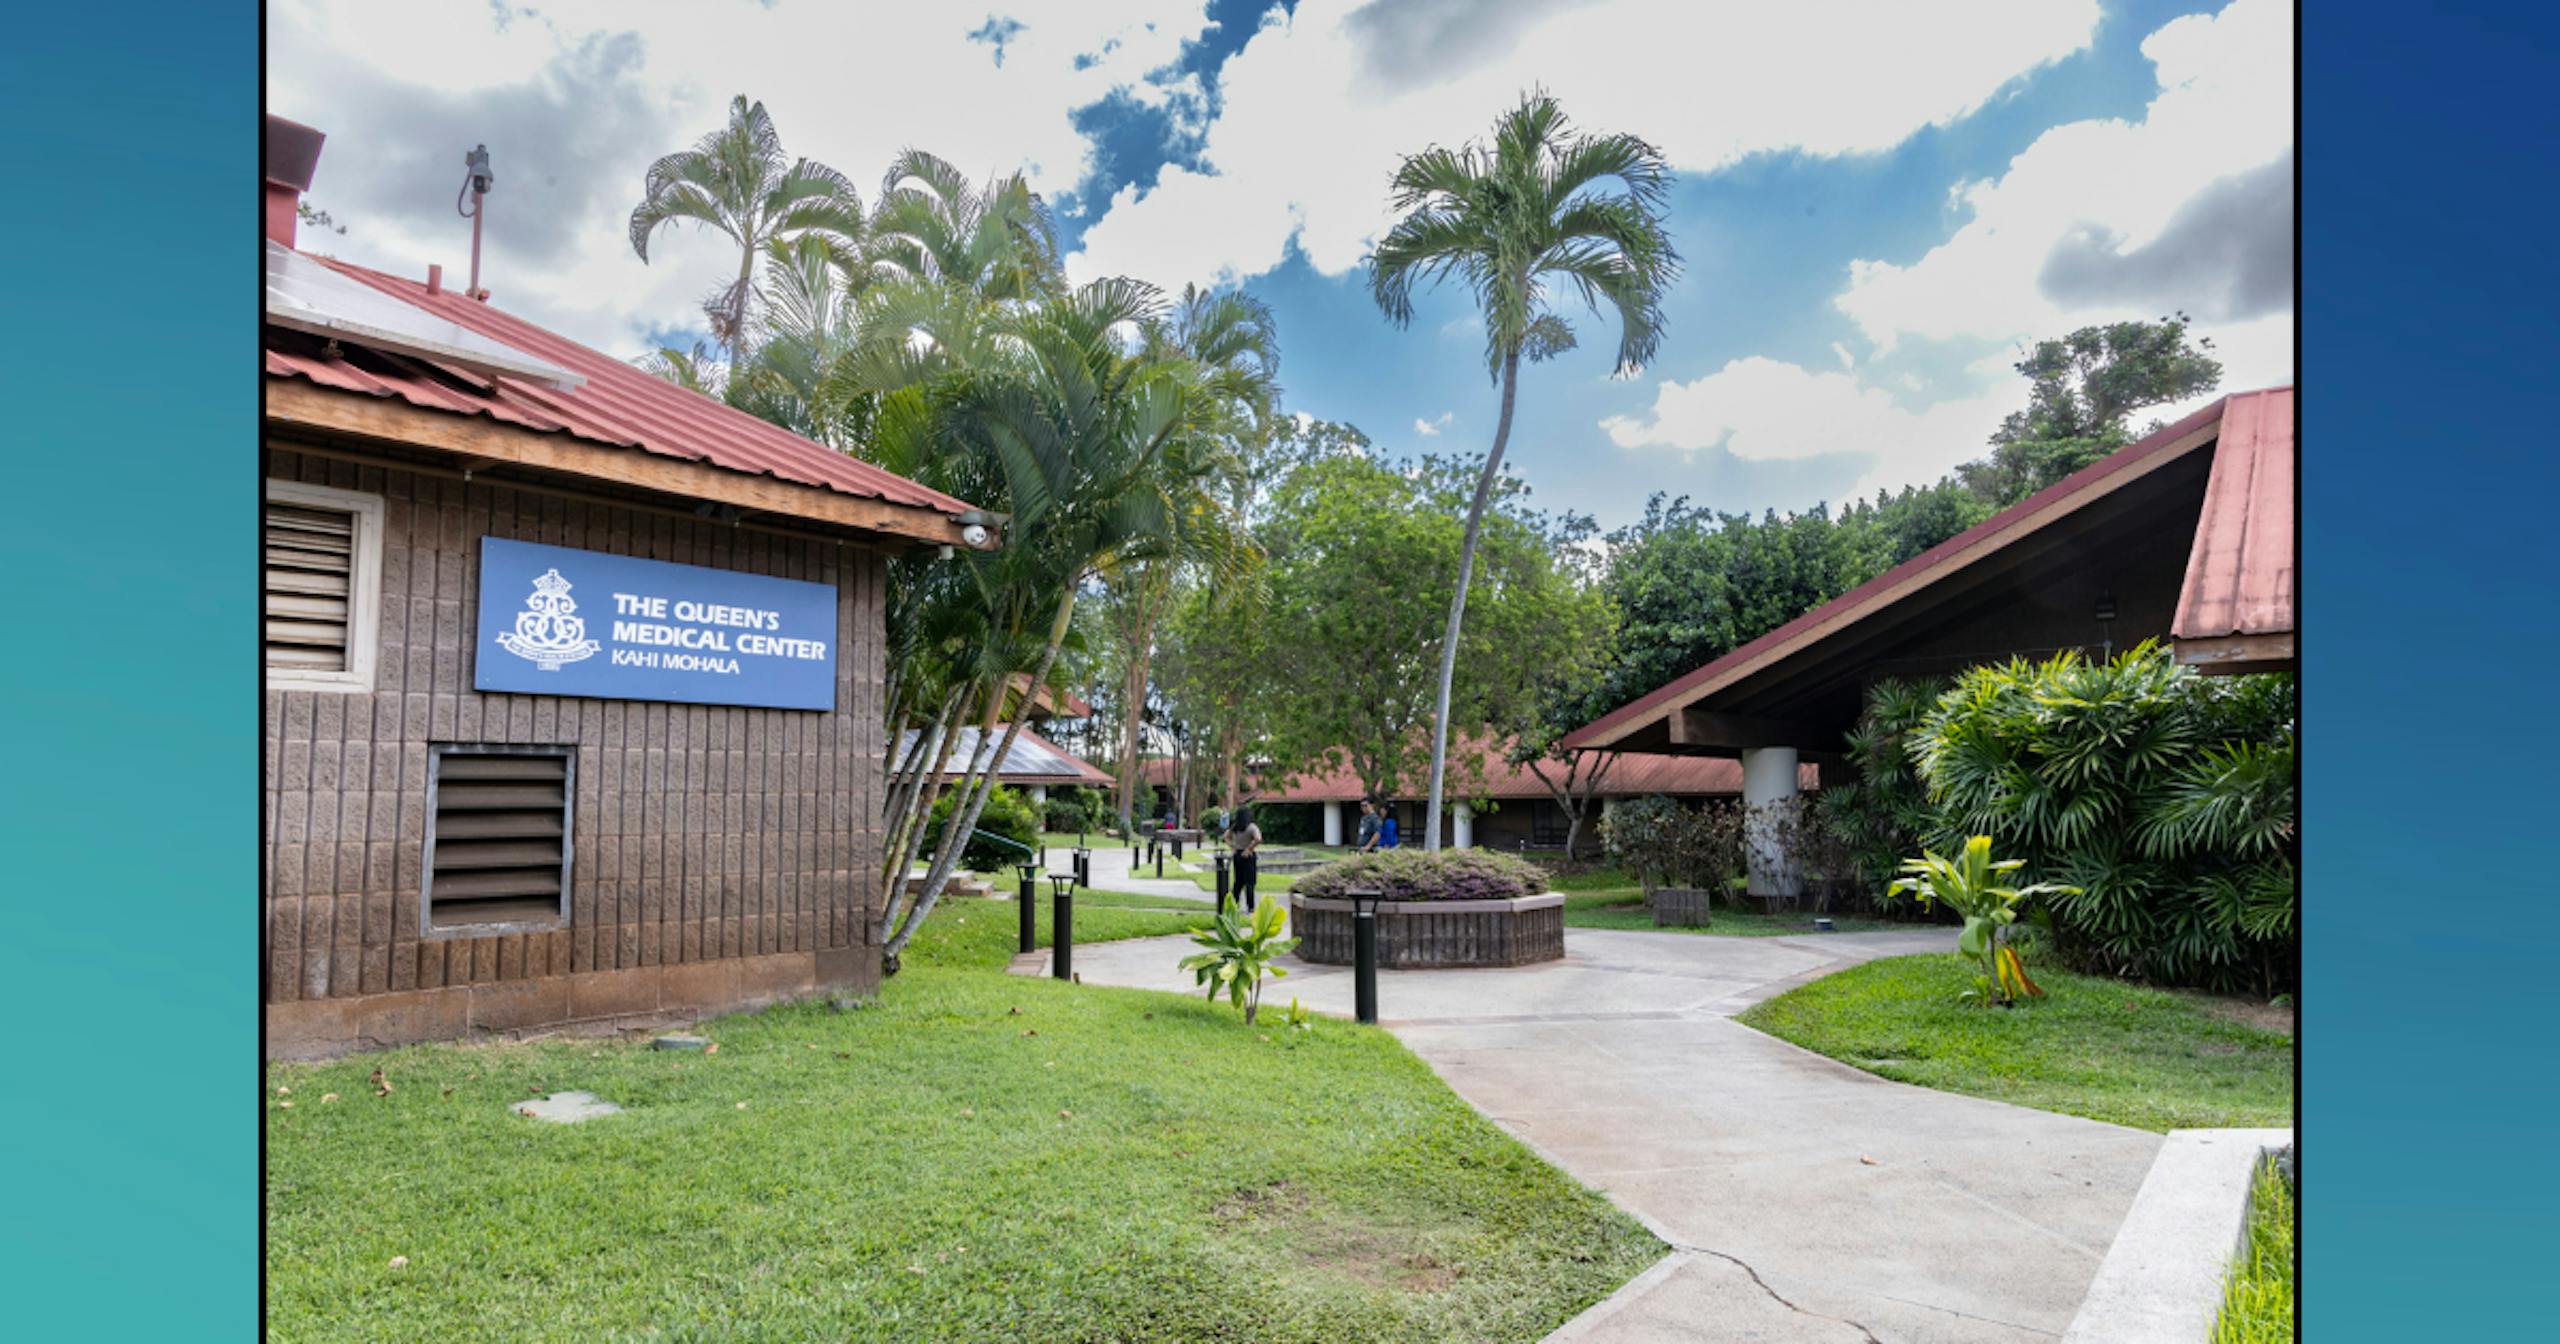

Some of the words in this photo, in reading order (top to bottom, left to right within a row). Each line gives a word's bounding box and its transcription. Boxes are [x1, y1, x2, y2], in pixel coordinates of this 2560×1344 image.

[612, 593, 668, 619] THE
[673, 601, 780, 631] QUEEN'S
[612, 620, 731, 652] MEDICAL
[736, 633, 826, 661] CENTER
[611, 649, 658, 668] KAHI
[662, 653, 740, 675] MOHALA
